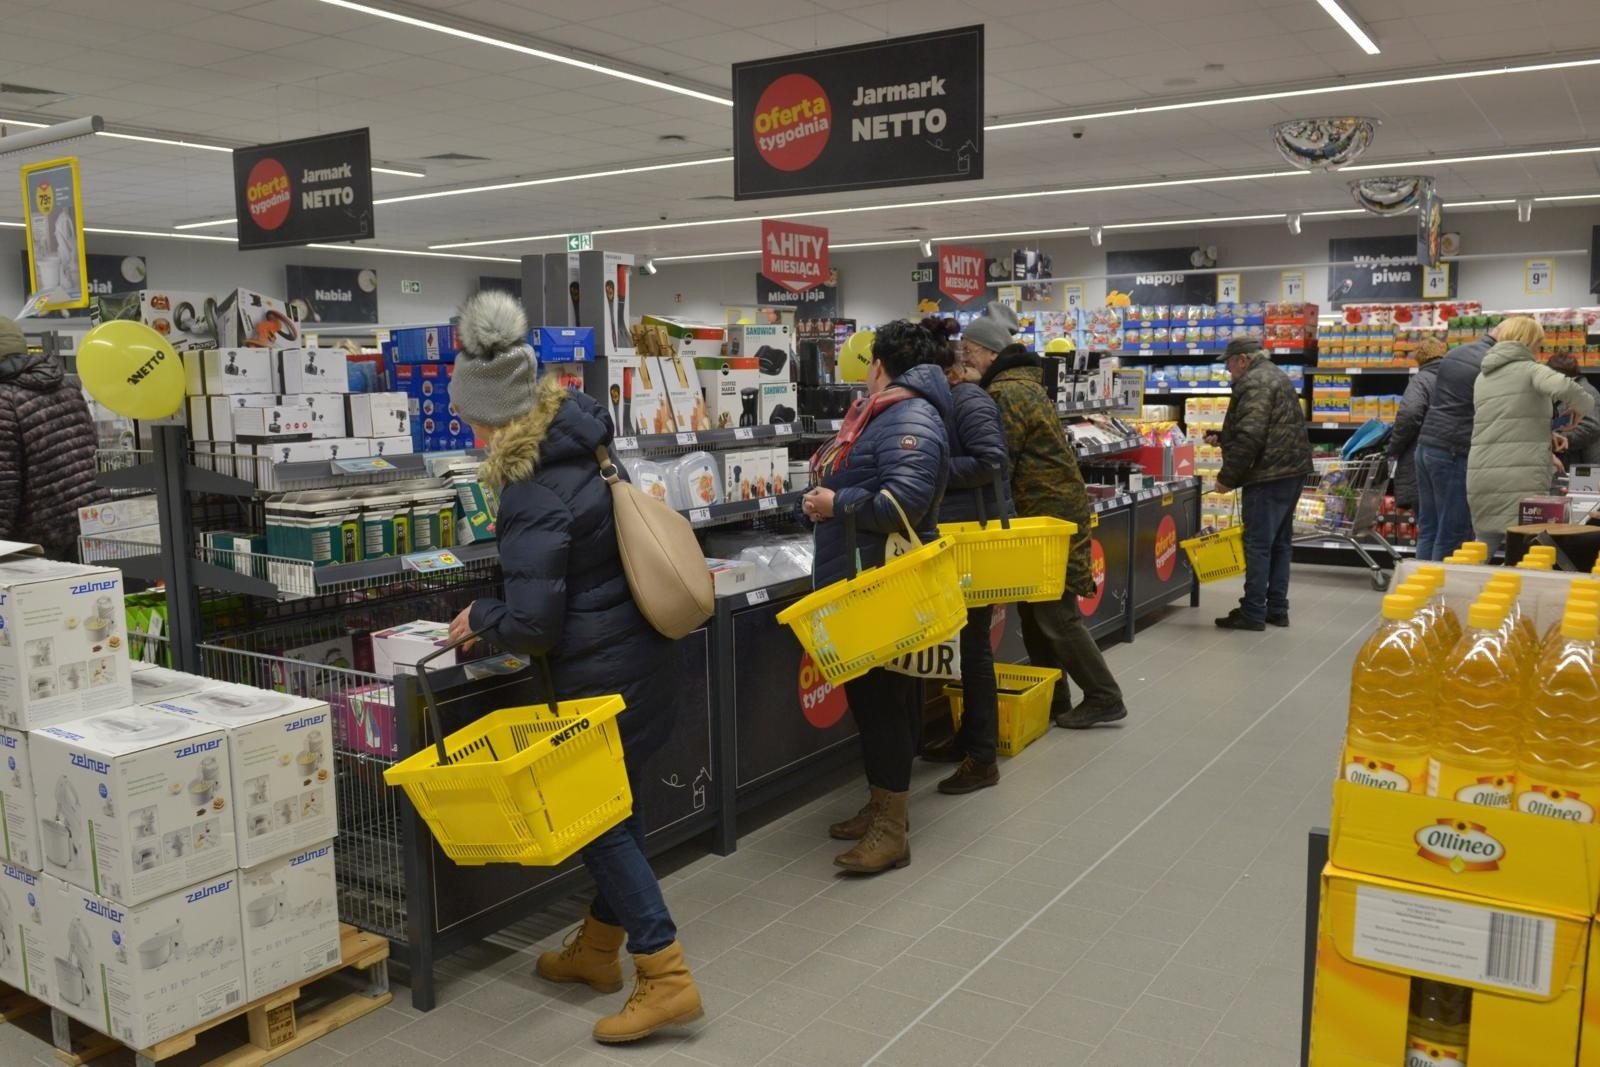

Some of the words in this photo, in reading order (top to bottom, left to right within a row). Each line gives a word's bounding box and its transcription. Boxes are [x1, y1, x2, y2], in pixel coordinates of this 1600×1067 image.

[853, 75, 946, 106] Jarmark
[755, 96, 827, 135] Oferta
[852, 108, 947, 142] NETTO
[759, 116, 829, 152] tygodnia
[302, 162, 352, 184] Jarmark
[247, 175, 289, 203] Oferta
[302, 185, 354, 210] NETTO
[250, 189, 290, 215] tygodnia
[782, 233, 824, 259] HITY
[771, 259, 820, 279] MIESIĄCA
[951, 255, 982, 276] HITY
[1353, 254, 1419, 270] Wyborn
[945, 276, 979, 292] MIESIĄCA
[1135, 272, 1185, 286] Napoje
[1372, 269, 1411, 286] piwa
[1430, 277, 1437, 289] 4
[315, 289, 352, 302] Nabiał
[768, 290, 799, 302] Mleko
[804, 290, 825, 303] jaja
[1223, 286, 1229, 297] 4
[745, 327, 776, 336] SANDWICH
[132, 350, 165, 380] NETTO
[763, 386, 788, 395] SANDWICH
[69, 578, 119, 595] zelmer
[803, 681, 832, 709] tygo
[284, 713, 328, 732] zelmer
[555, 718, 590, 743] NETTO
[174, 738, 224, 759] zelmer
[69, 752, 111, 775] zelmer
[1350, 770, 1397, 791] Ollineo
[1527, 799, 1583, 823] Ollineo
[1427, 829, 1496, 858] Ollineo
[289, 845, 332, 866] zelmer
[2, 863, 38, 886] zelmer
[185, 879, 233, 904] zelmer
[83, 897, 125, 924] zelmer
